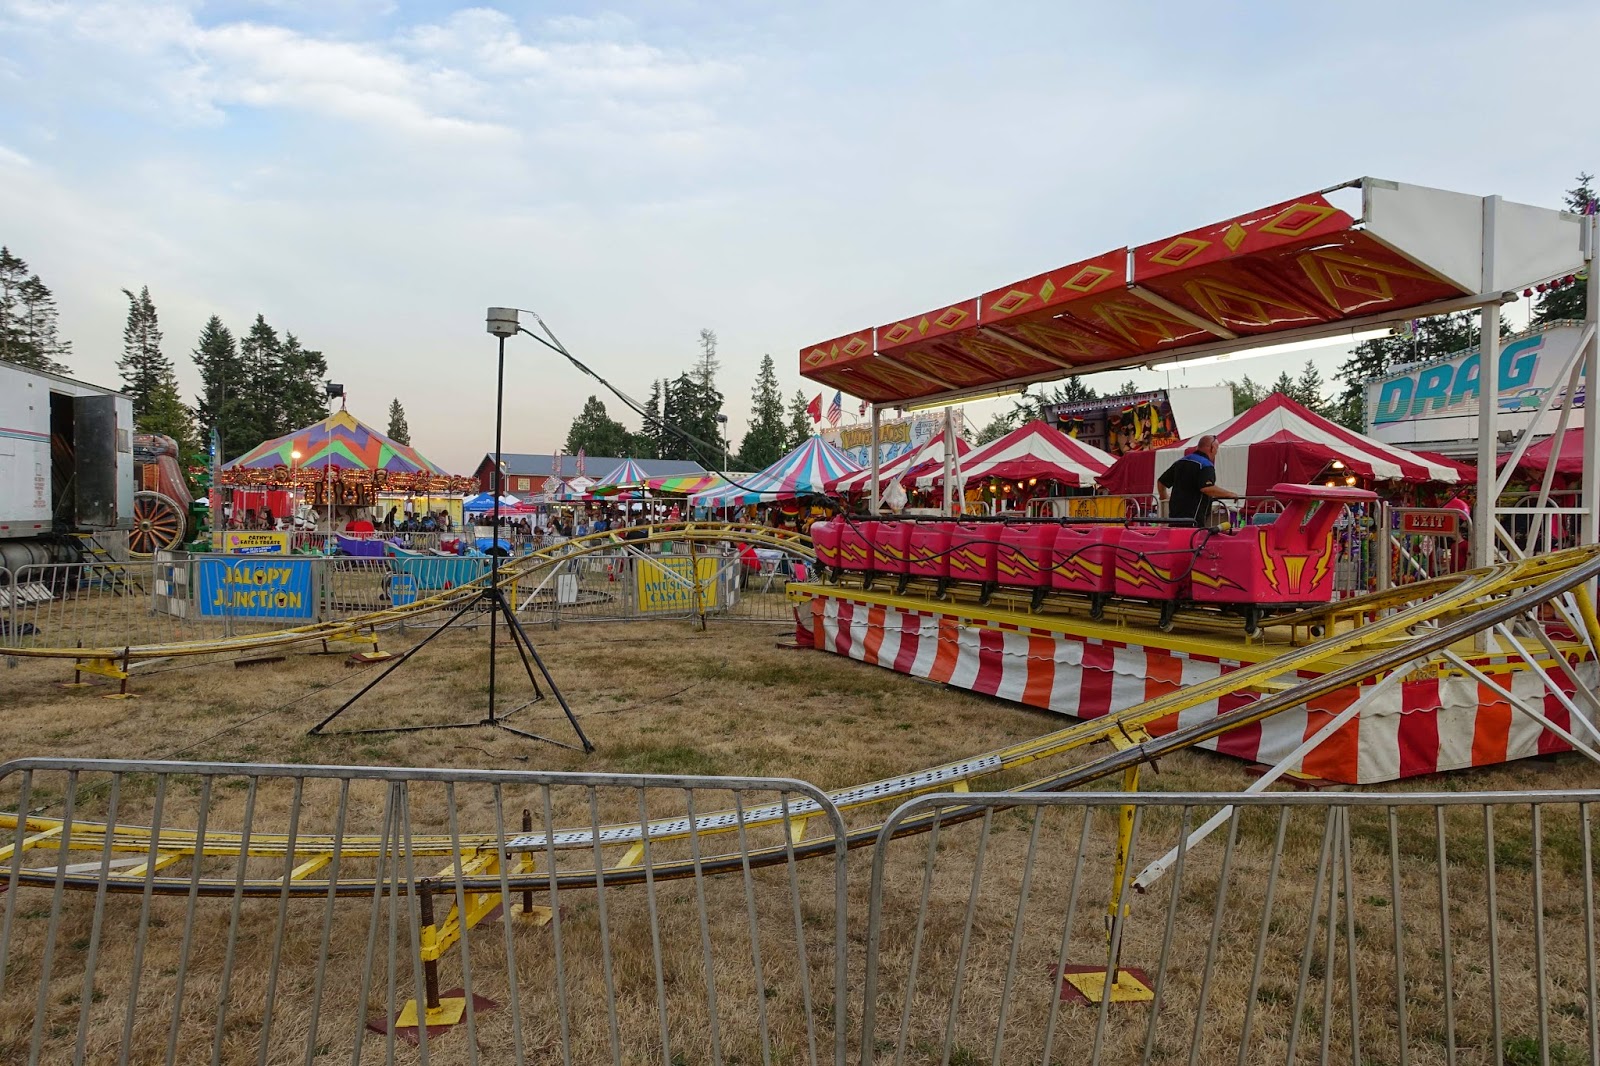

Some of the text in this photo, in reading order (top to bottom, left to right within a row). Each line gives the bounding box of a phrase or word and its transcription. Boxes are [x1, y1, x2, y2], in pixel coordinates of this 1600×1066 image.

[1374, 334, 1543, 424] DRAG
[1412, 514, 1445, 528] EXIT
[223, 567, 292, 585] JALOPY
